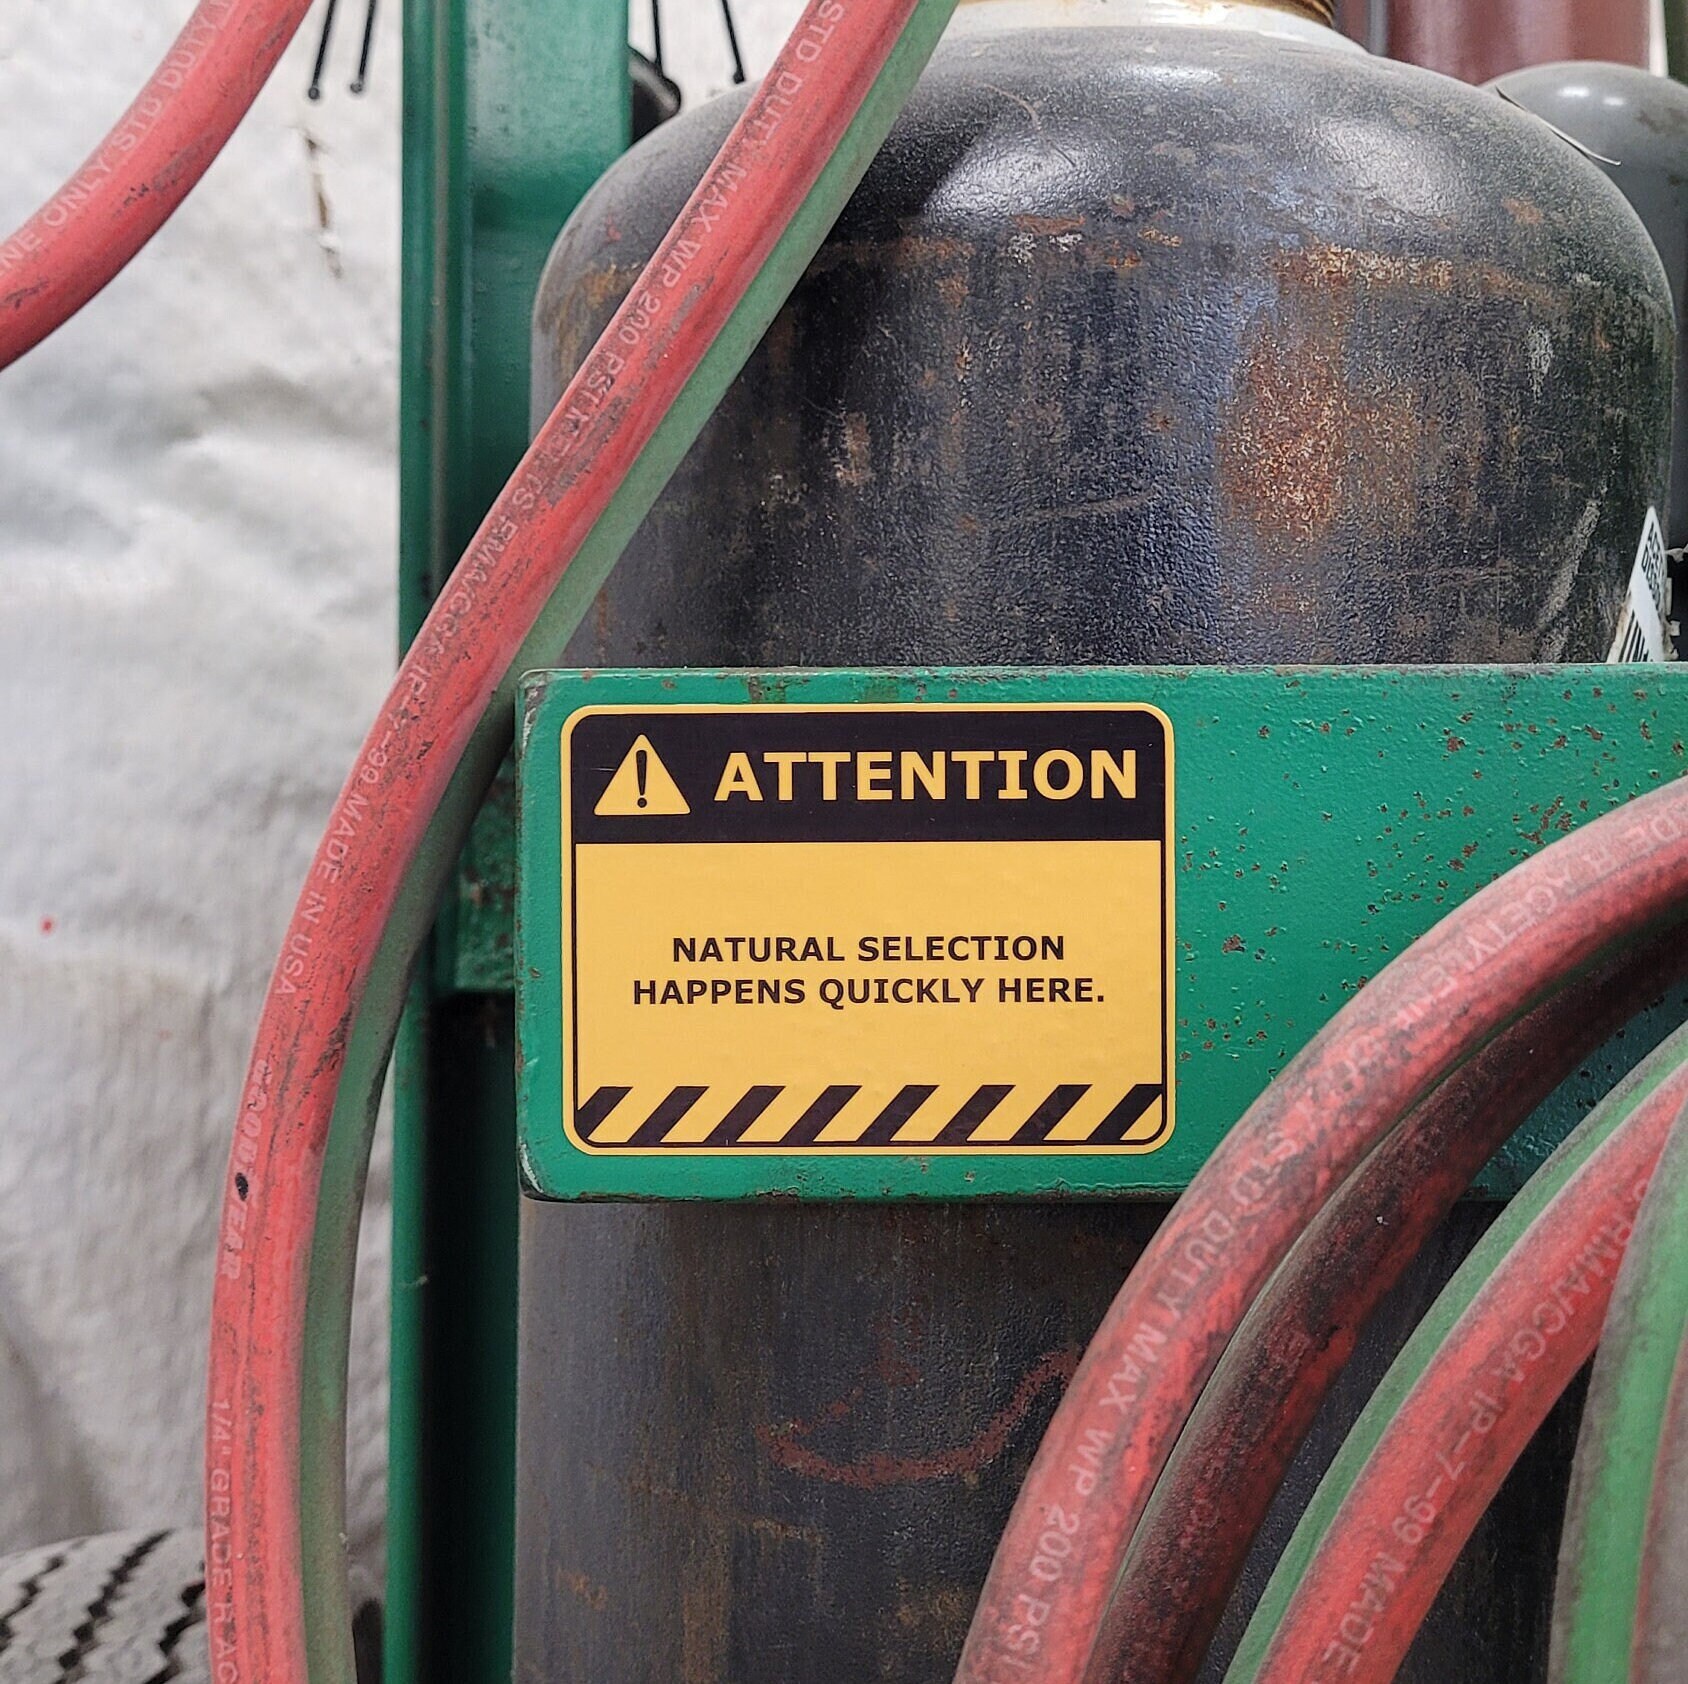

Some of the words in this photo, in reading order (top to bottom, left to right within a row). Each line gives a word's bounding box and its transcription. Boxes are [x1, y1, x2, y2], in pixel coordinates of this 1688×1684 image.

[794, 0, 844, 62] STD
[42, 153, 111, 226] ONLY
[111, 94, 162, 152] STD
[689, 160, 748, 234] MAX
[654, 233, 701, 290] WP
[615, 289, 663, 348] 200
[714, 749, 1137, 801] ATTENTION
[315, 791, 368, 883] MADE
[299, 890, 328, 924] IN
[274, 932, 313, 994] USA
[672, 937, 845, 963] NATURAL
[857, 935, 1065, 962] SELECTION
[633, 980, 806, 1006] HAPPENS
[819, 978, 985, 1009] QUICKLY
[998, 978, 1105, 1004] HERE.
[1098, 1321, 1168, 1413] MAX
[1068, 1429, 1114, 1497] WP
[1388, 1388, 1504, 1547] IP-7-99
[210, 1467, 232, 1586] GRADE
[1031, 1504, 1082, 1583] 200
[1320, 1551, 1405, 1675] MADE
